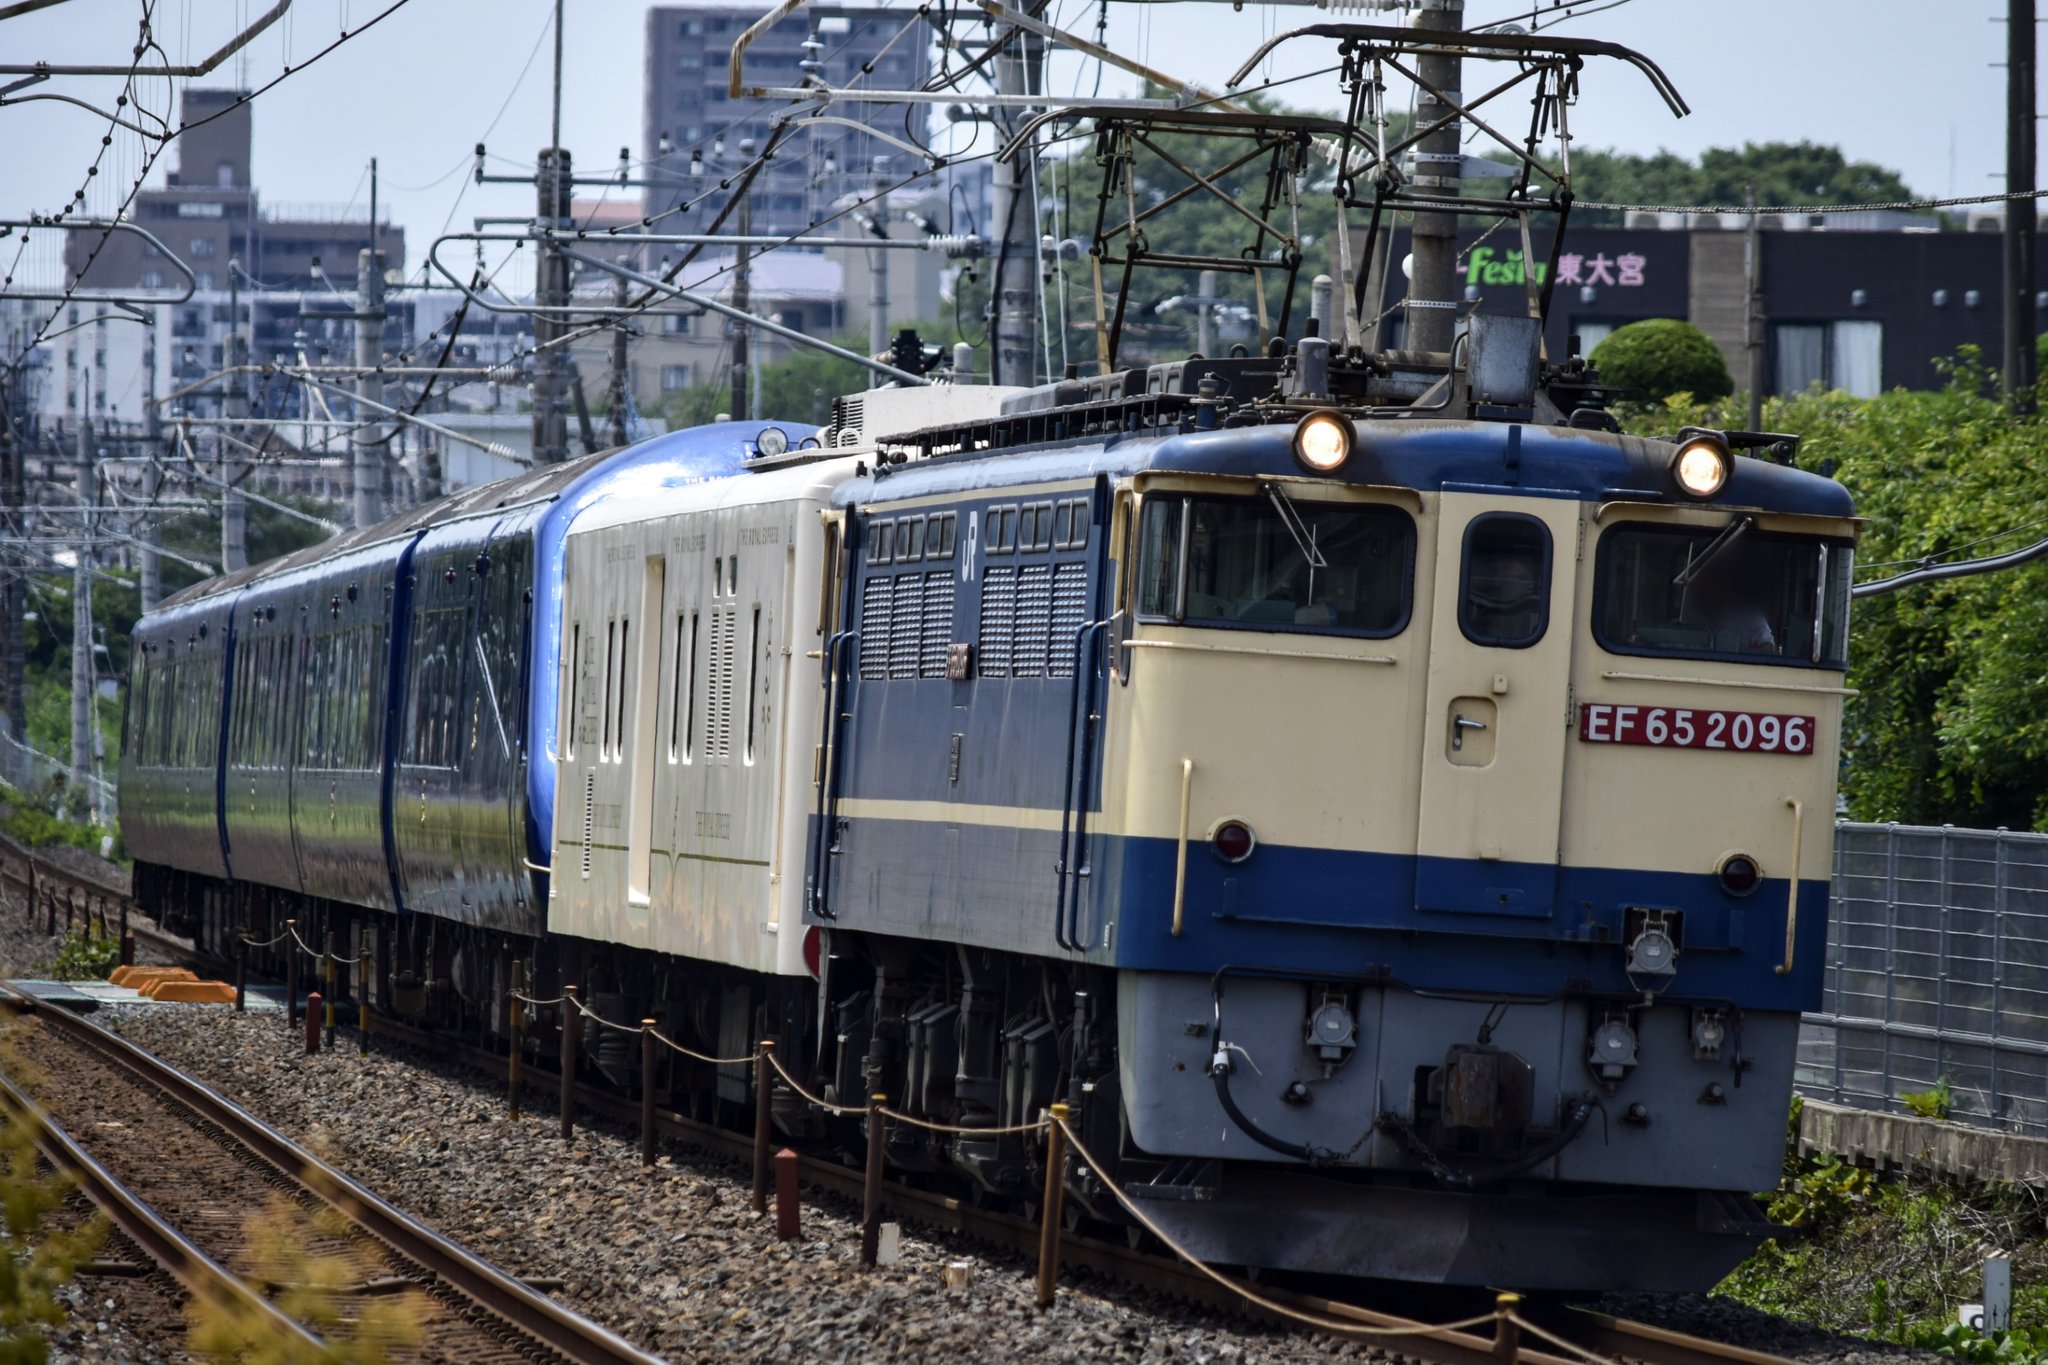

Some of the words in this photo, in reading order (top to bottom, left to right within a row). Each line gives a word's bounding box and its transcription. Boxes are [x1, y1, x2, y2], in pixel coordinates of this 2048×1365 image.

[1555, 253, 1646, 286] 東大宮
[962, 511, 978, 582] JR
[1705, 712, 1806, 751] 2096
